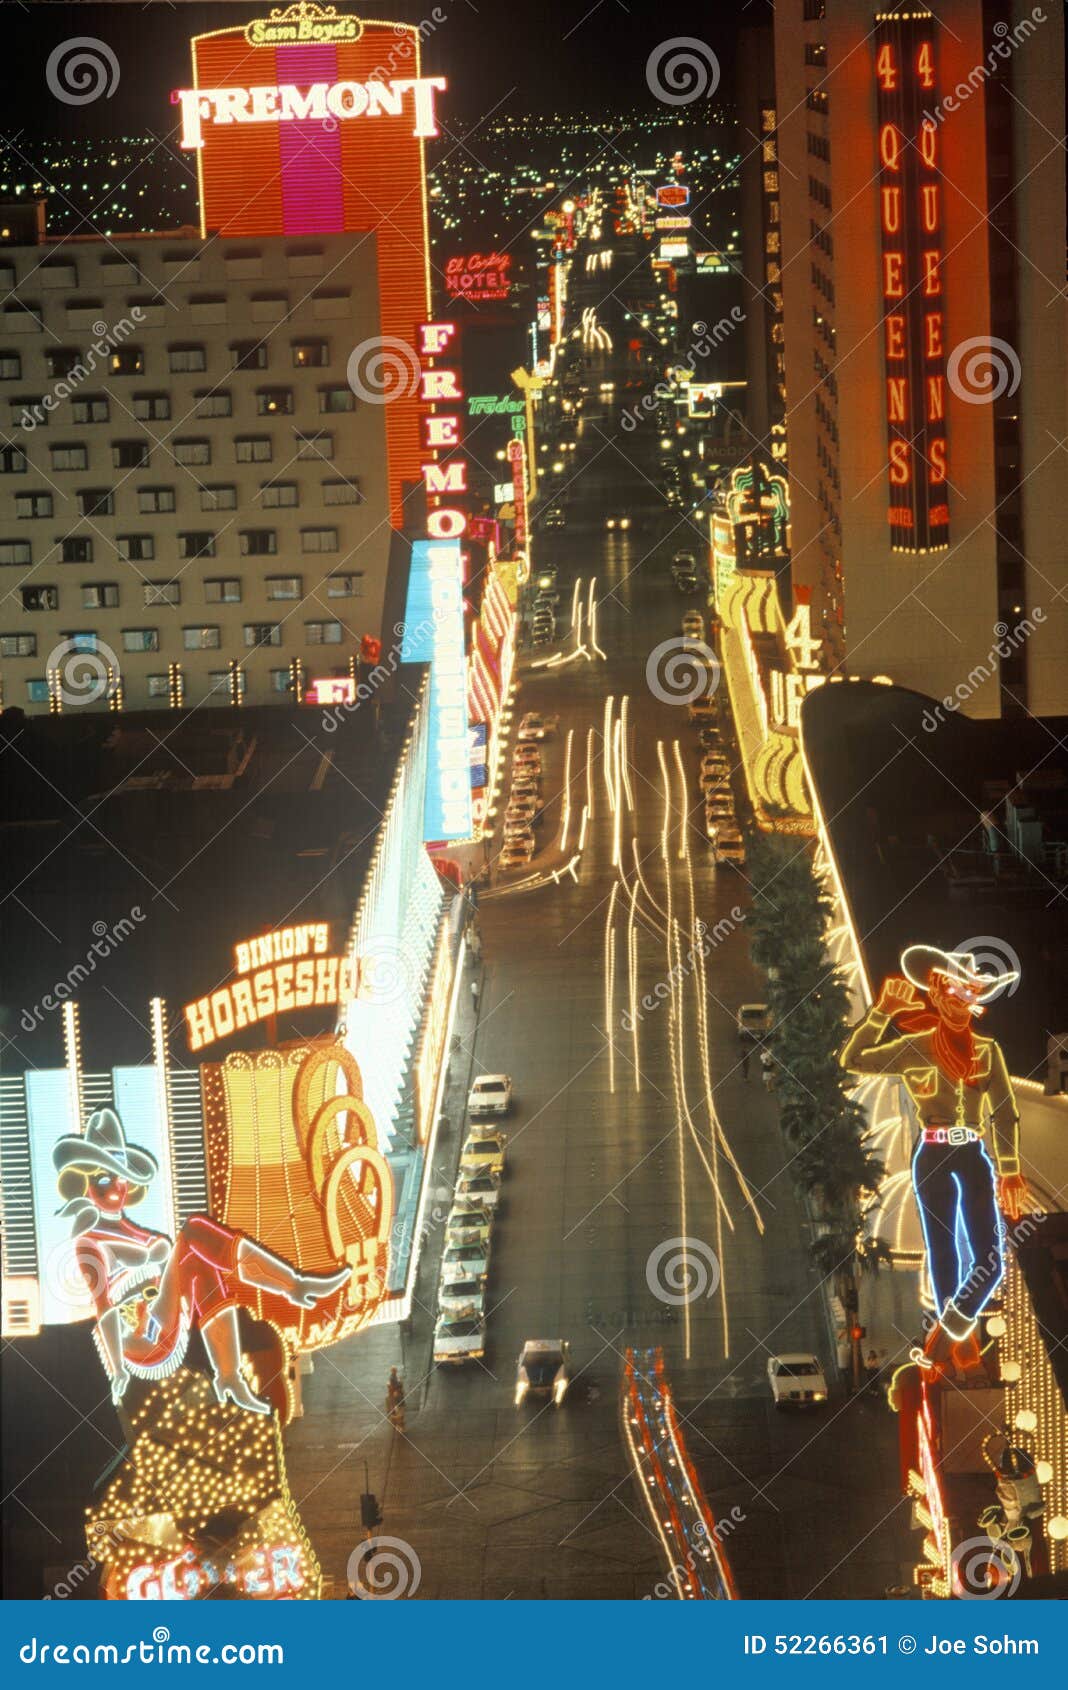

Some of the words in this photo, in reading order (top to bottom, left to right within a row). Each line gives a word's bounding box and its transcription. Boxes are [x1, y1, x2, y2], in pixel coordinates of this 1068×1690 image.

[252, 23, 297, 42] Sam
[297, 19, 357, 42] Boyd's
[877, 44, 896, 89] 4
[917, 42, 934, 88] 4
[172, 76, 447, 149] FREMONT
[446, 272, 511, 289] HOTEL
[879, 122, 910, 487] QUEENS
[920, 120, 946, 485] QUEENS
[468, 394, 526, 415] Trader
[420, 323, 468, 612] FREMO
[785, 604, 823, 669] 4
[235, 923, 328, 974] BINION'S
